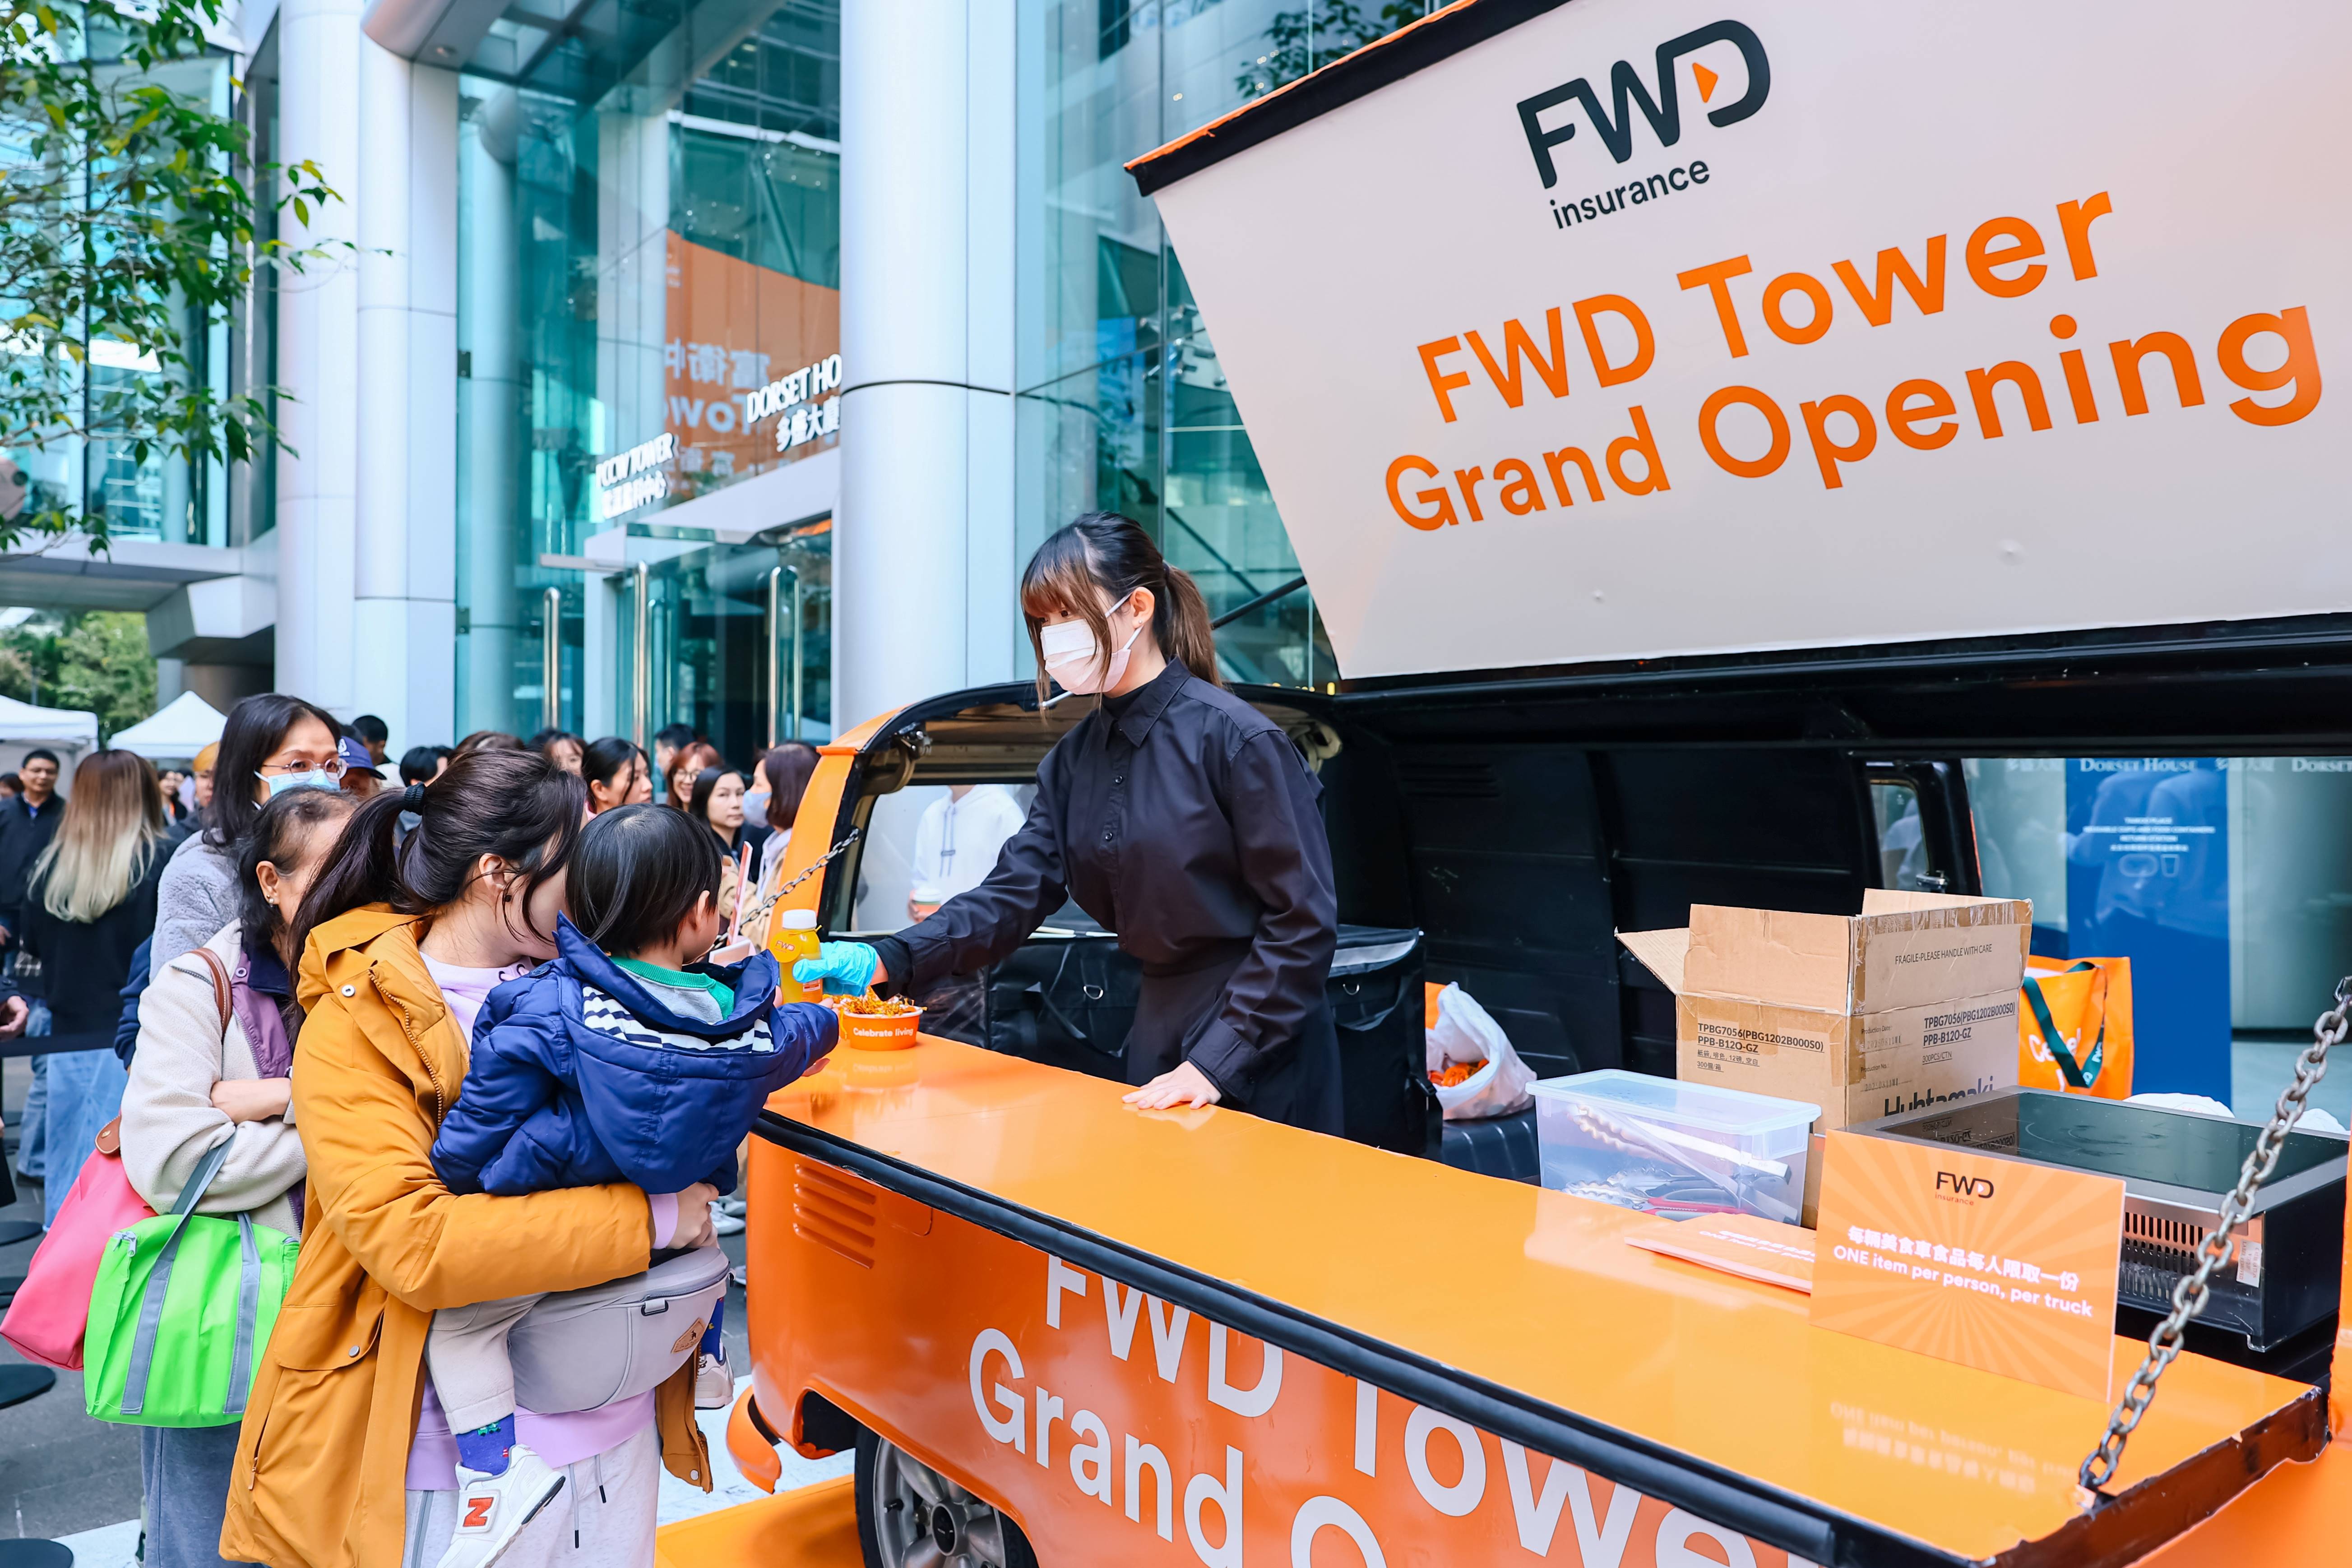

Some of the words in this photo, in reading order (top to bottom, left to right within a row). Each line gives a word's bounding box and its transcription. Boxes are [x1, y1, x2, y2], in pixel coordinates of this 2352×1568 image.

[1517, 19, 1771, 190] FWD
[1550, 161, 1710, 229] insurance
[1416, 293, 1655, 423] FWD
[1676, 191, 2112, 359] Tower
[747, 366, 810, 424] DORSET
[1385, 405, 1671, 531] Grand
[1698, 305, 2322, 490] Opening
[629, 432, 674, 475] TOWER
[776, 940, 795, 951] FWD
[1895, 951, 1940, 965] FRAGILE-PLEASE
[1941, 948, 1963, 959] HANDLE
[1963, 946, 1978, 955] WITH
[1979, 944, 1992, 953] CARE
[853, 1027, 893, 1037] Celebrate
[895, 1027, 914, 1036] living
[1698, 1023, 1824, 1051] TPBG7056(PBG1202B000S0)
[1861, 1026, 1881, 1035] Production
[1713, 1052, 1727, 1061] 啡色,
[1922, 1051, 1952, 1063] 300PCS/CTN
[1935, 1171, 1994, 1198] FWD
[1935, 1192, 1974, 1206] insurance
[1848, 1226, 2079, 1291] 每輛美食車食品每人限取一份
[1833, 1245, 1868, 1265] ONE
[1873, 1253, 1908, 1274] item
[1912, 1266, 1940, 1281] per
[1943, 1274, 2006, 1300] person,
[2010, 1288, 2040, 1303] per
[2045, 1293, 2093, 1317] truck
[1046, 1254, 1283, 1418] FWD
[969, 1328, 1244, 1568] Grand
